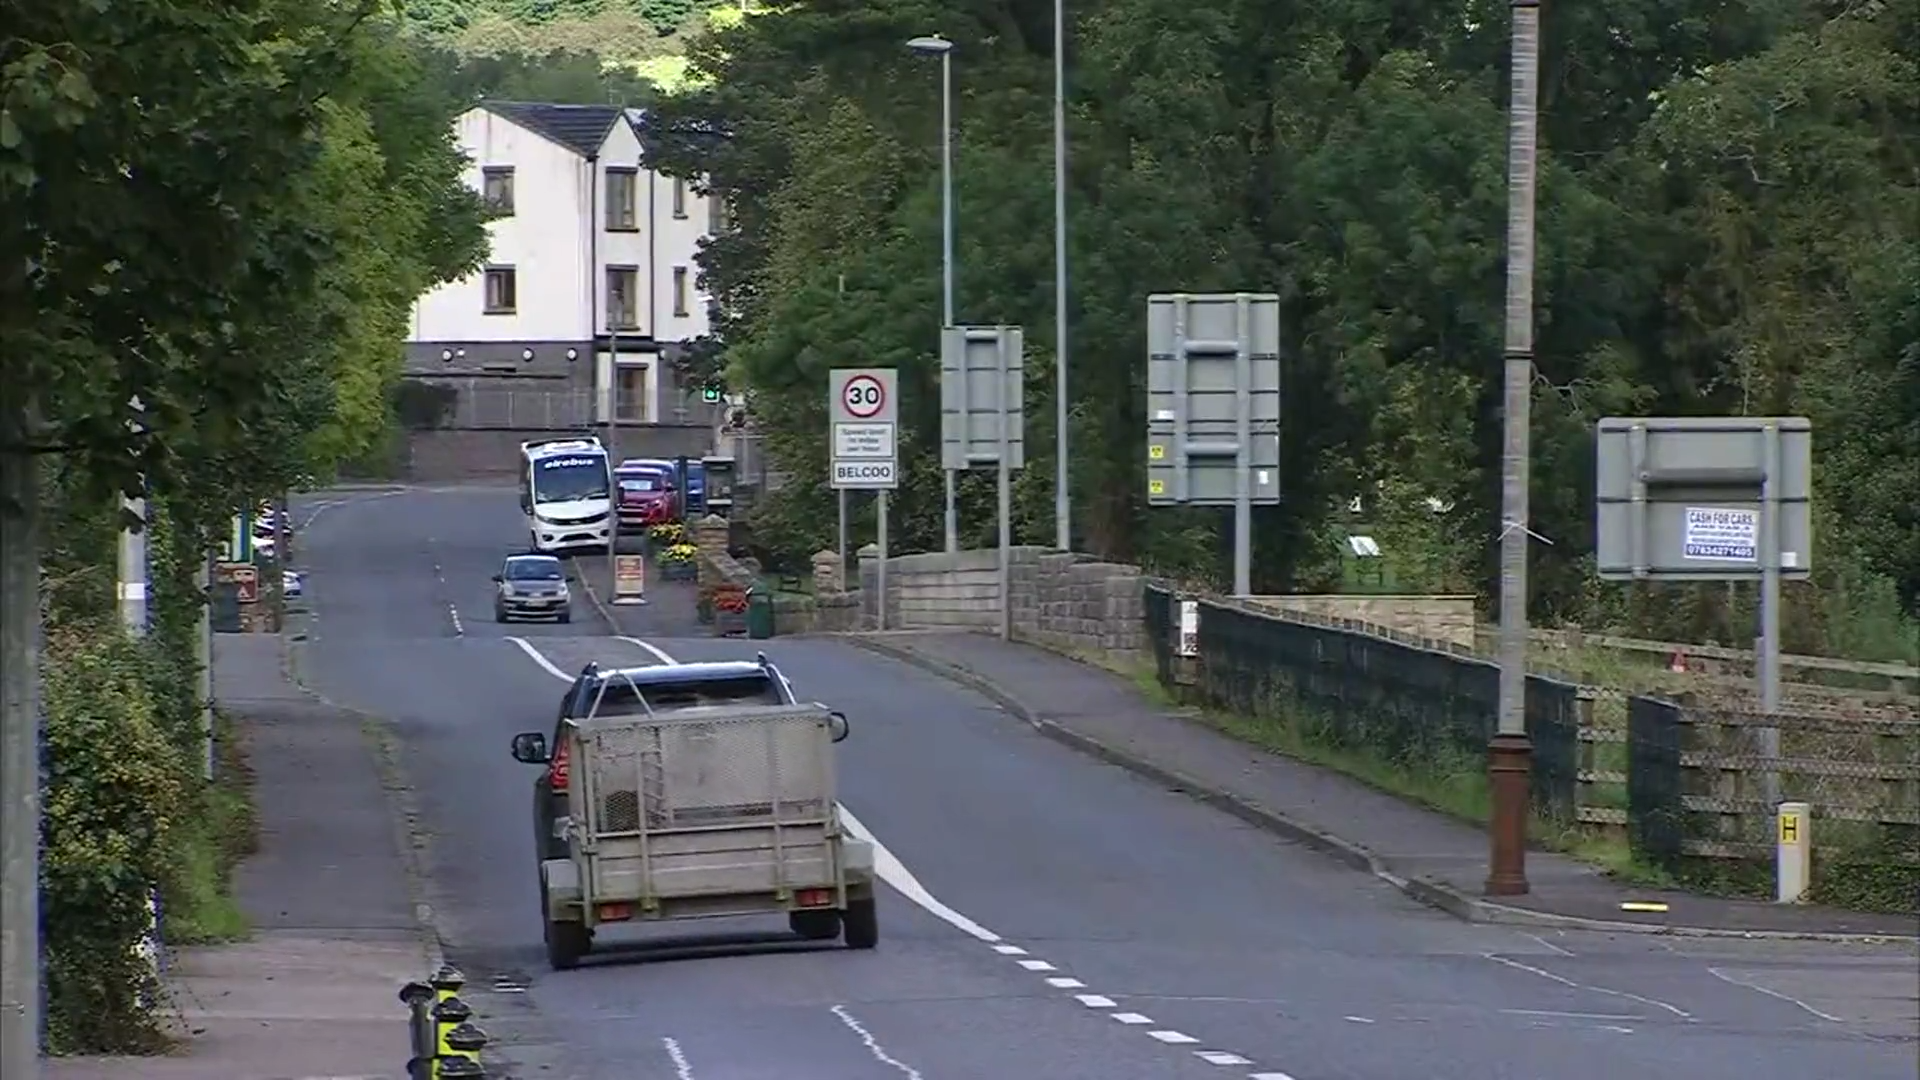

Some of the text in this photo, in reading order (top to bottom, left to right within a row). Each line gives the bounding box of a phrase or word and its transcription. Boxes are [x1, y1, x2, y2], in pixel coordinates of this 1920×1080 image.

[849, 387, 879, 404] 30
[838, 466, 890, 478] BELCOO
[1690, 512, 1752, 525] CASH FOR CARS
[1783, 816, 1797, 841] H
